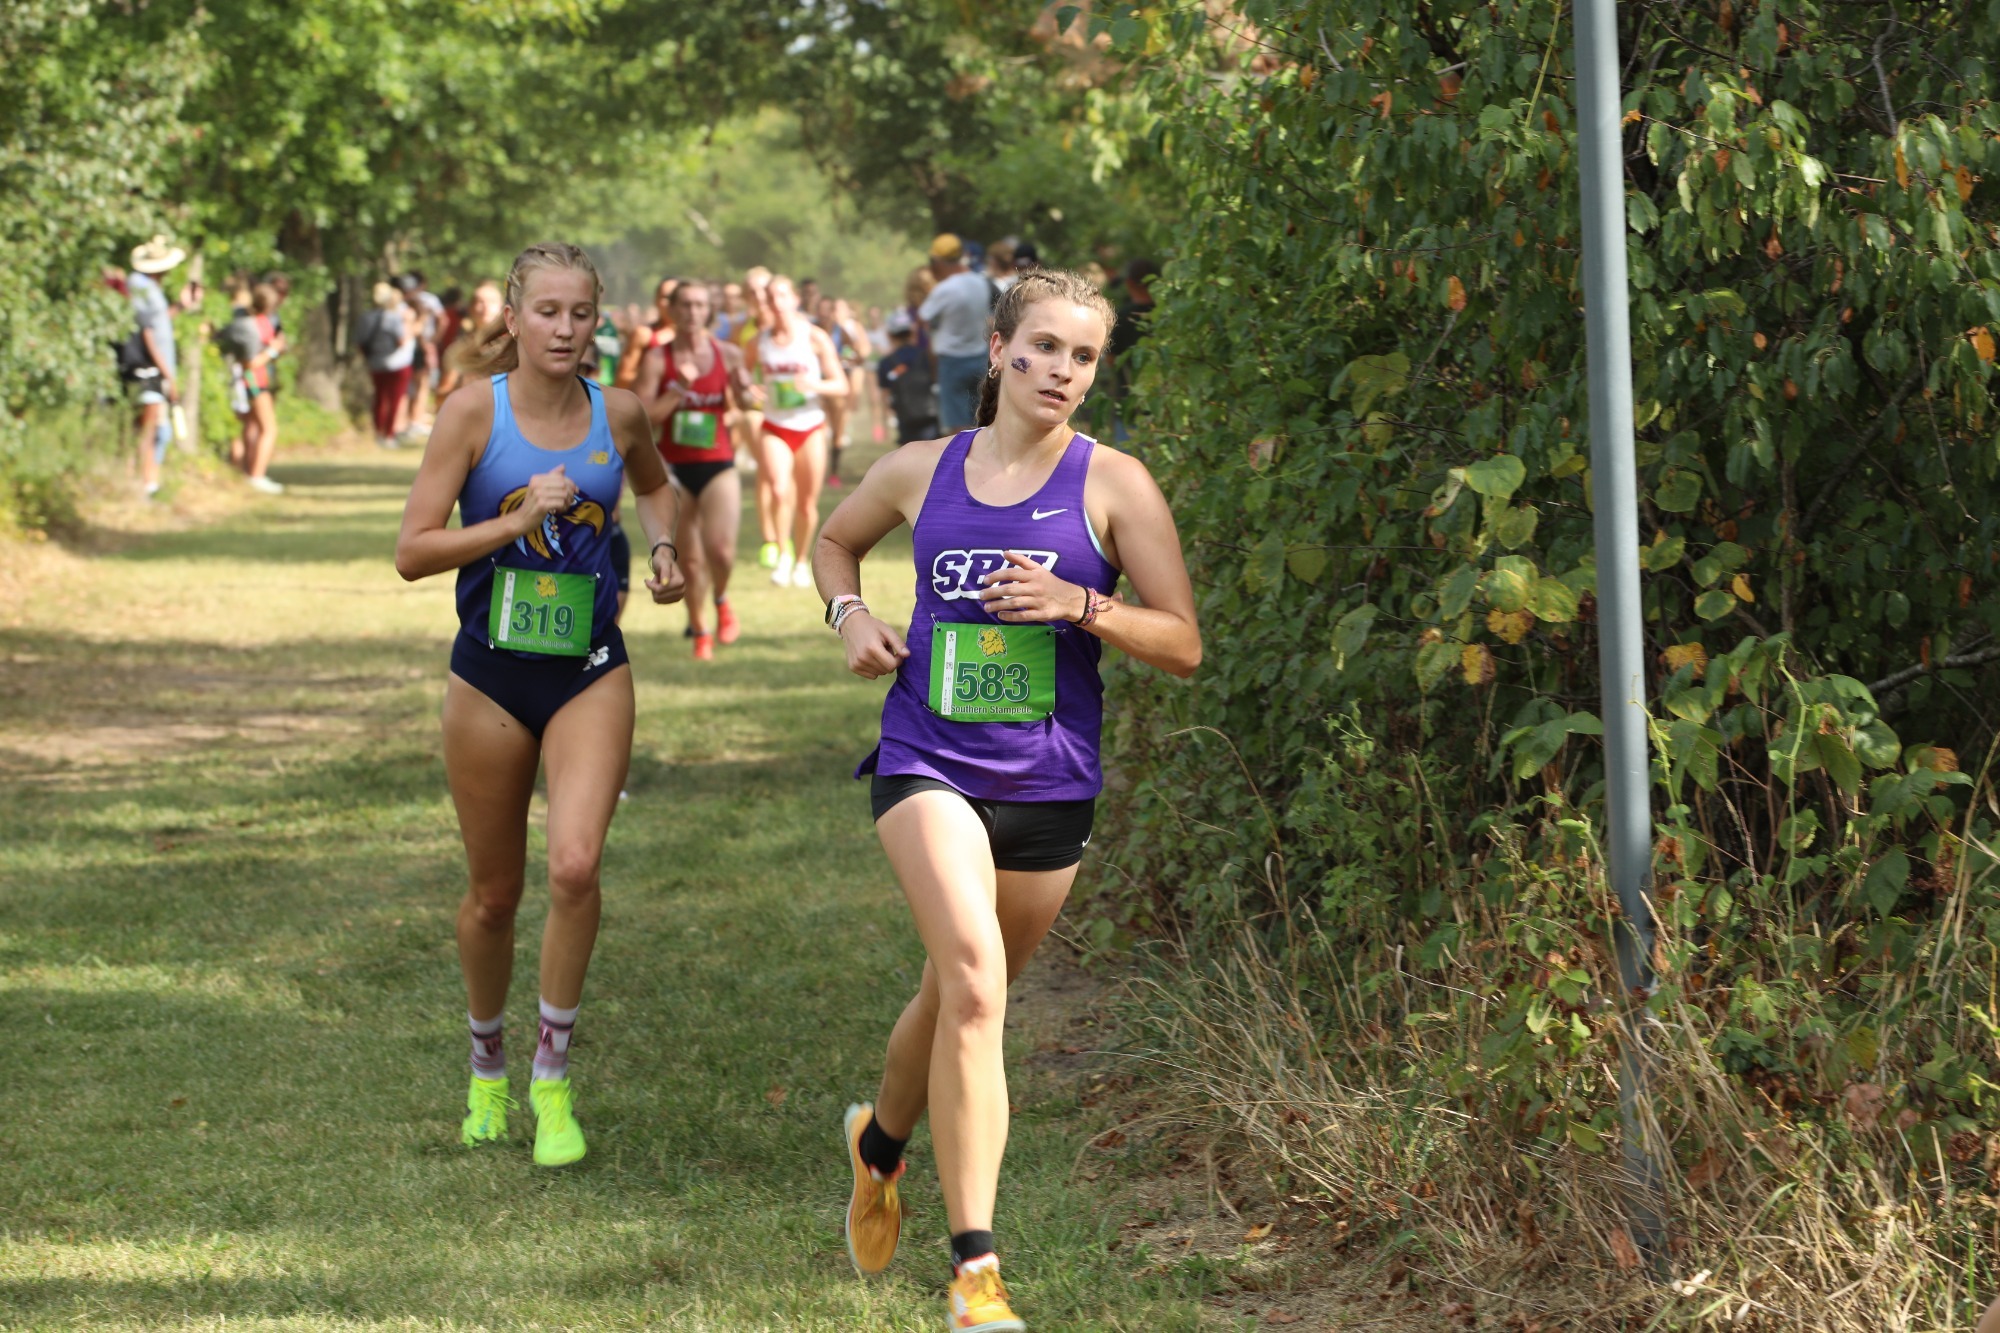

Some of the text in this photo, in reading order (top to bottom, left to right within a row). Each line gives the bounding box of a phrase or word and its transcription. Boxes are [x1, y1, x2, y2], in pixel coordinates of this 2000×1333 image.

[511, 601, 574, 638] 319
[955, 662, 1029, 702] 583
[951, 704, 1032, 716] Southern Stampede
